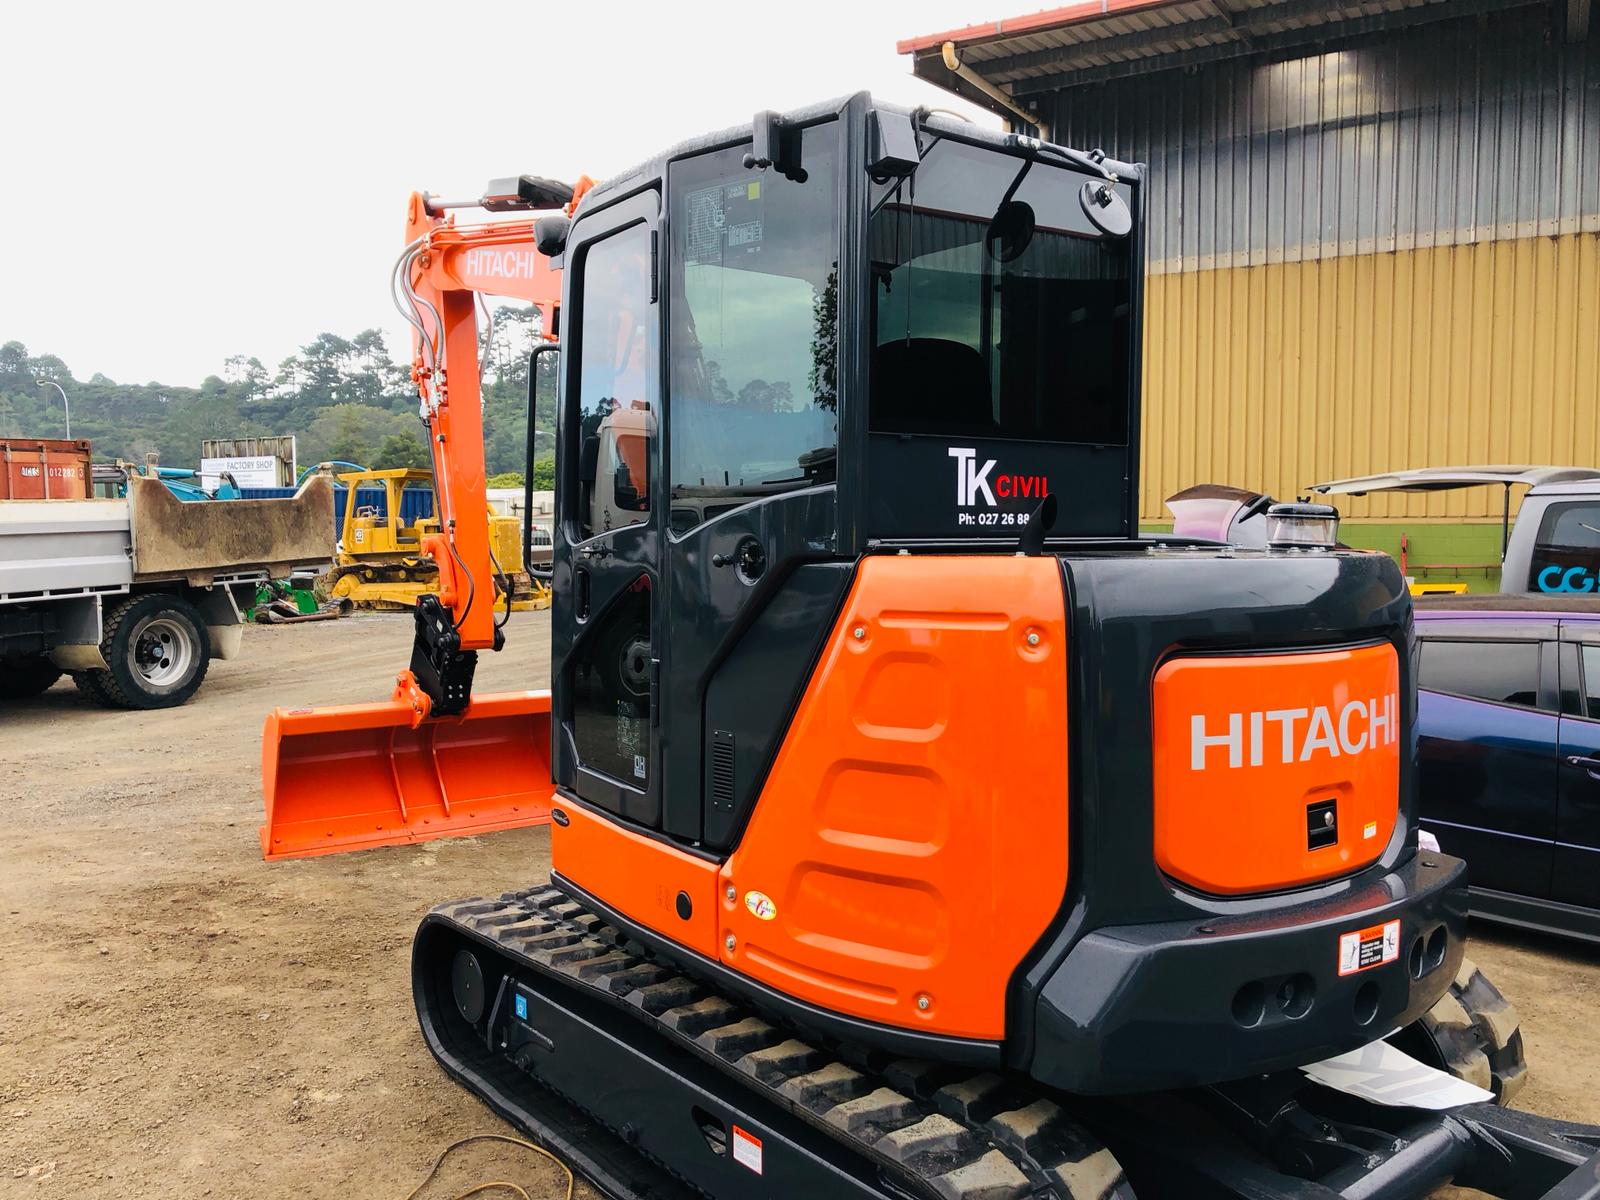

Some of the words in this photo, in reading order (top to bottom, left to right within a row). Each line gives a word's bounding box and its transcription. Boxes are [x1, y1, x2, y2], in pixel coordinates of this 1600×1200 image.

[466, 249, 535, 279] HITACHI
[226, 461, 254, 470] FACTORY
[256, 460, 273, 469] SHOP
[948, 447, 997, 506] TK
[996, 475, 1048, 498] CIVIL
[958, 512, 975, 525] Ph:
[978, 514, 998, 525] 027
[1001, 514, 1014, 525] 26
[1191, 693, 1396, 771] HITACHI
